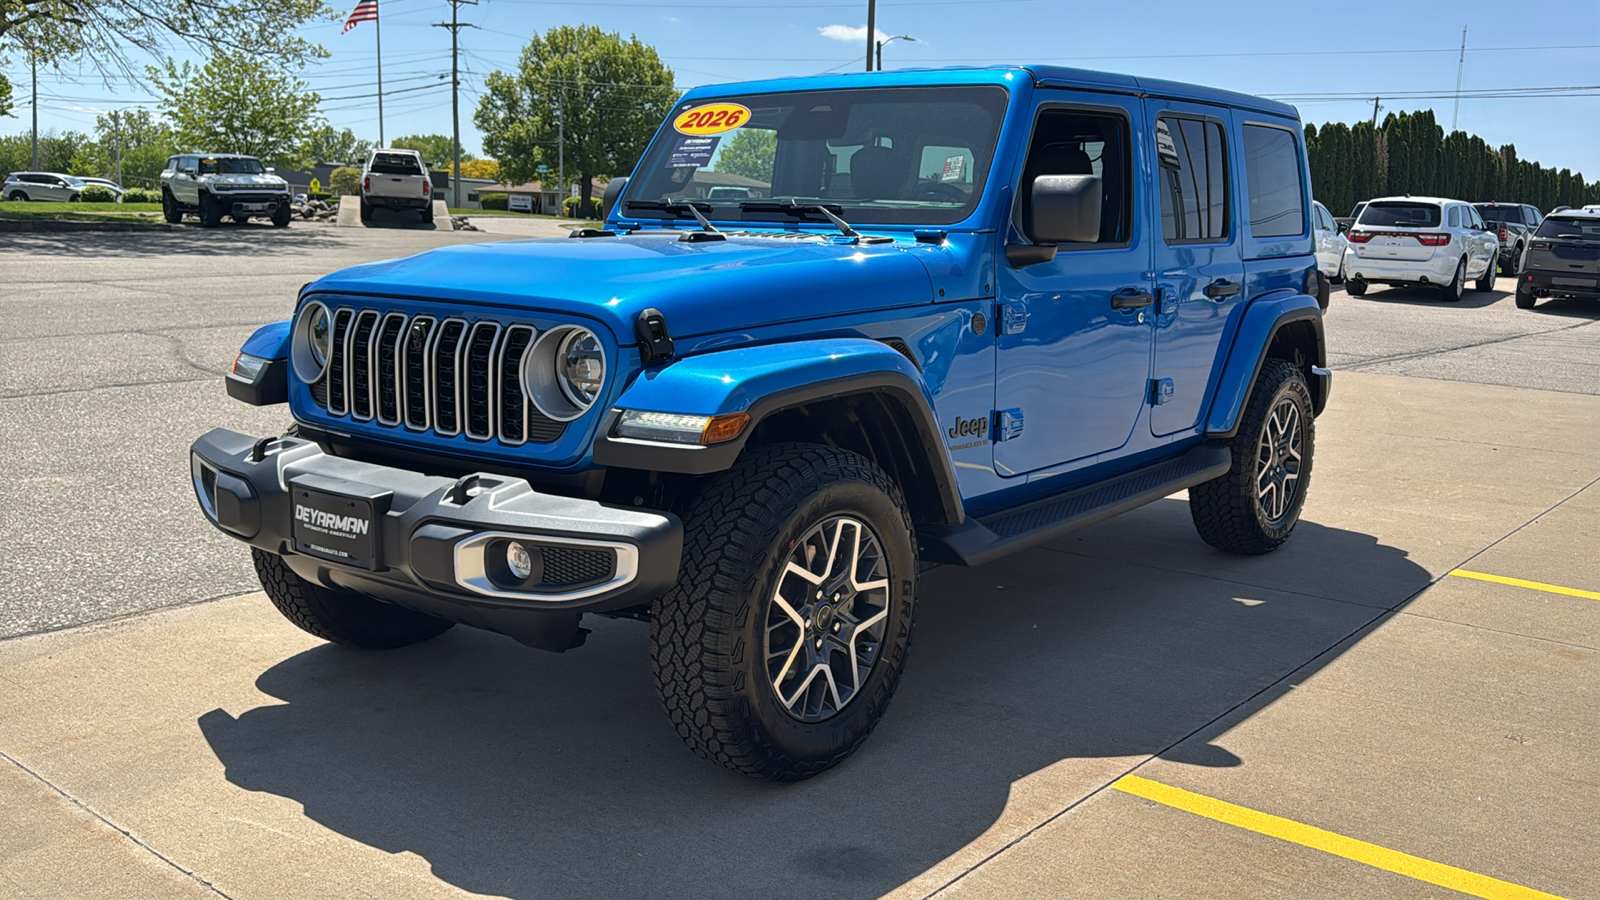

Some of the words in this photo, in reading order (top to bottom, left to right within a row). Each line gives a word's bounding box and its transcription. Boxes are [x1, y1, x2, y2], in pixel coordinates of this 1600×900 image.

[680, 110, 743, 128] 2026
[949, 416, 988, 438] Jeep
[295, 504, 369, 534] DEYARMAN
